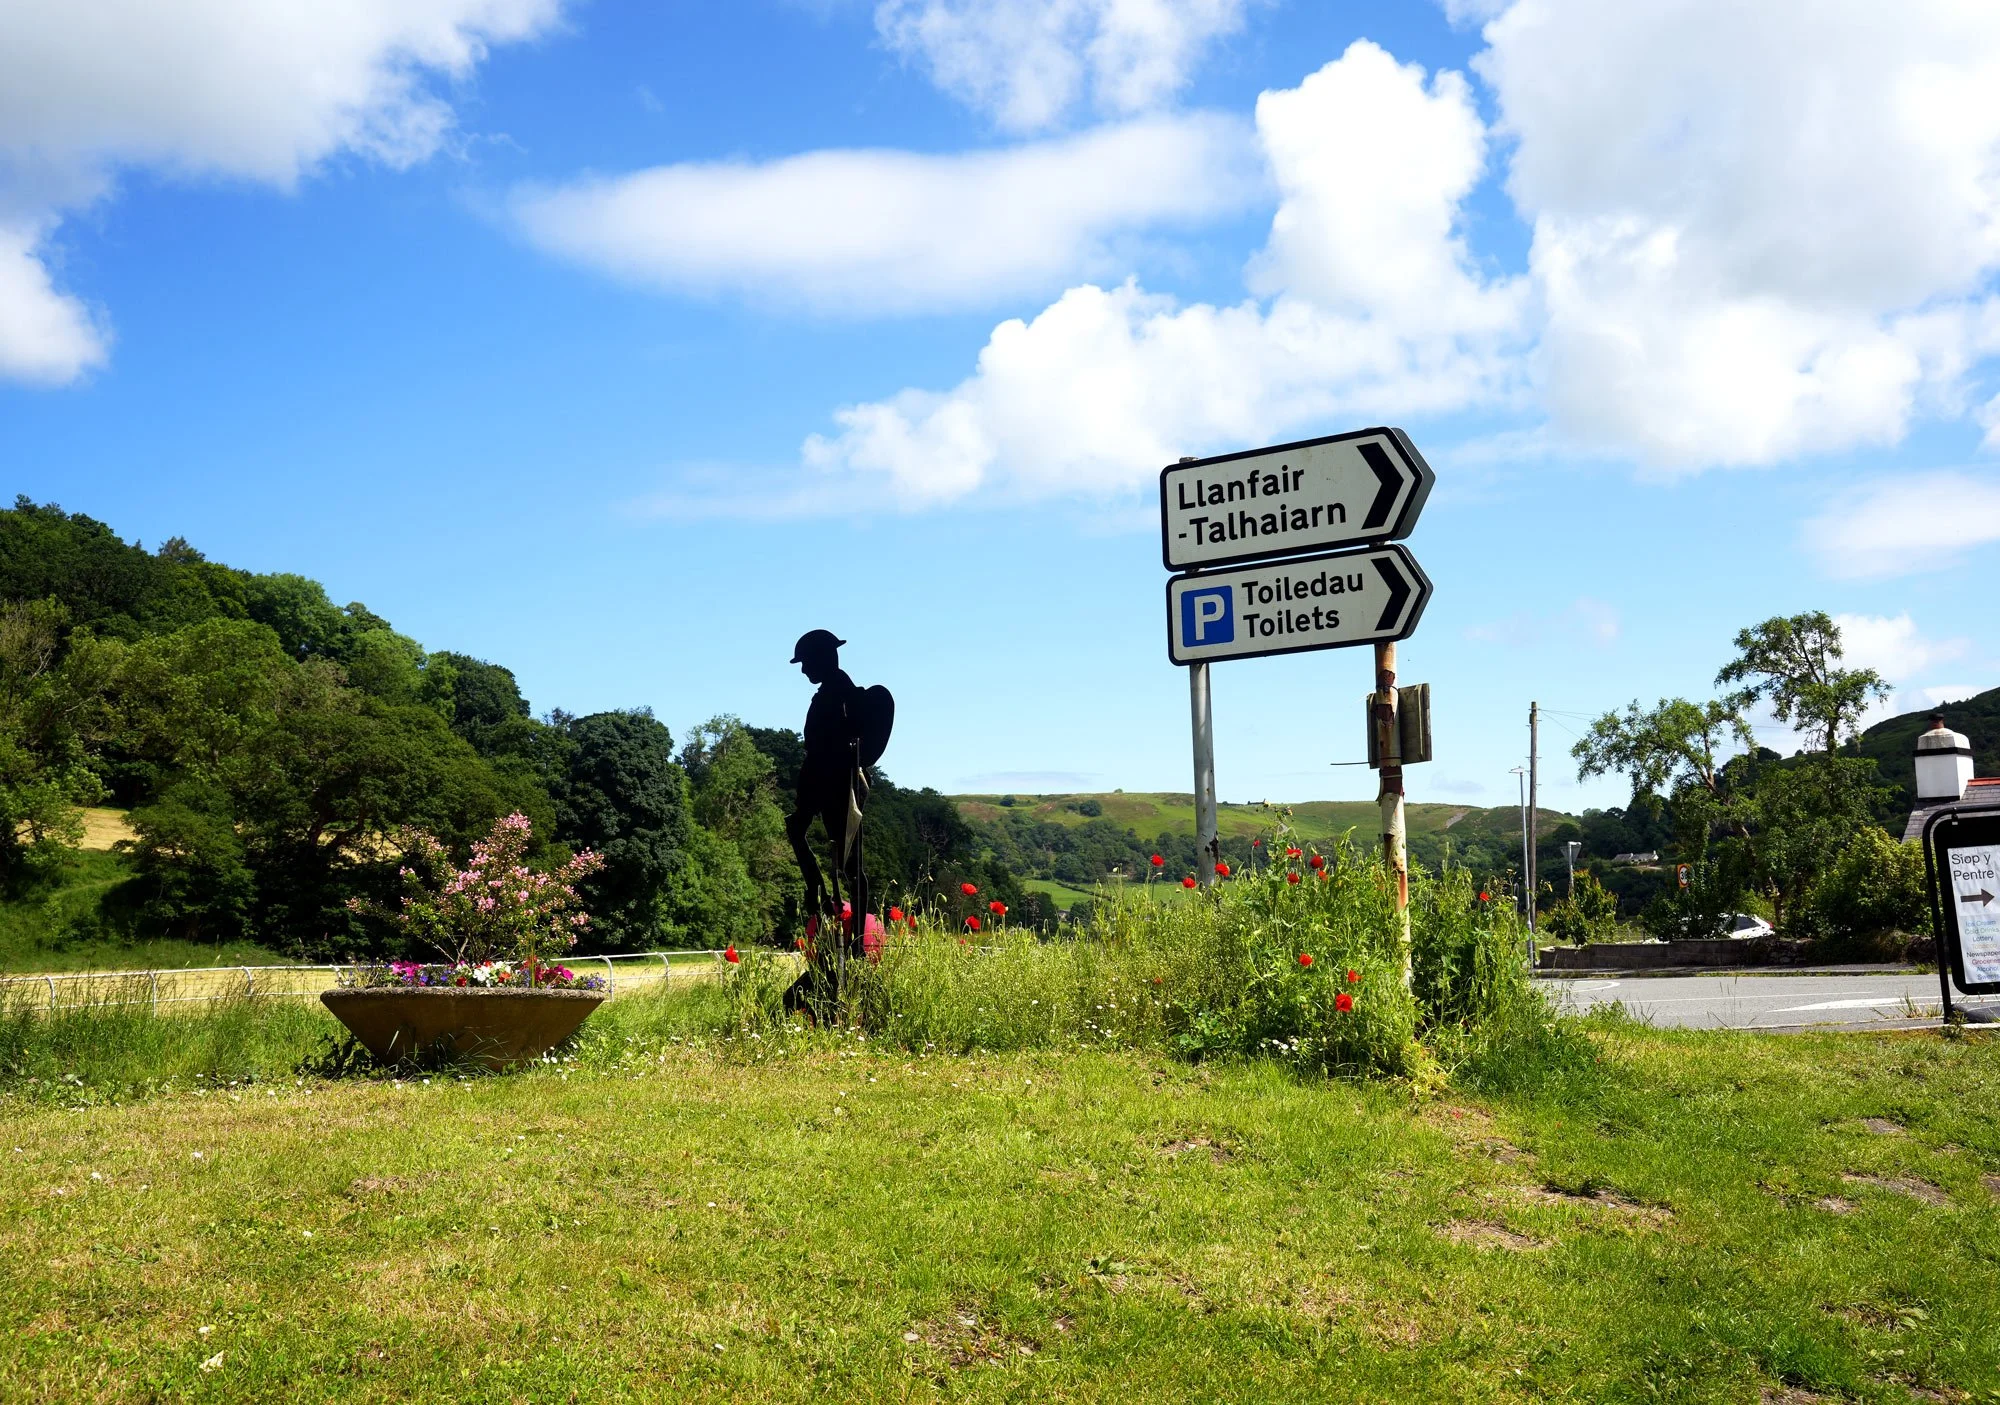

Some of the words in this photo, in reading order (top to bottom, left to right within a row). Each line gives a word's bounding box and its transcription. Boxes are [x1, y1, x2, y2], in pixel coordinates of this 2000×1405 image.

[1178, 465, 1304, 510] Llanfair
[1178, 502, 1346, 545] -Talhaiarn
[1242, 572, 1363, 605] Toiledau
[1194, 594, 1225, 641] P
[1243, 606, 1340, 638] Toilets
[1951, 853, 1980, 866] Siop
[1983, 854, 1991, 865] y
[1953, 869, 1994, 881] Pentre
